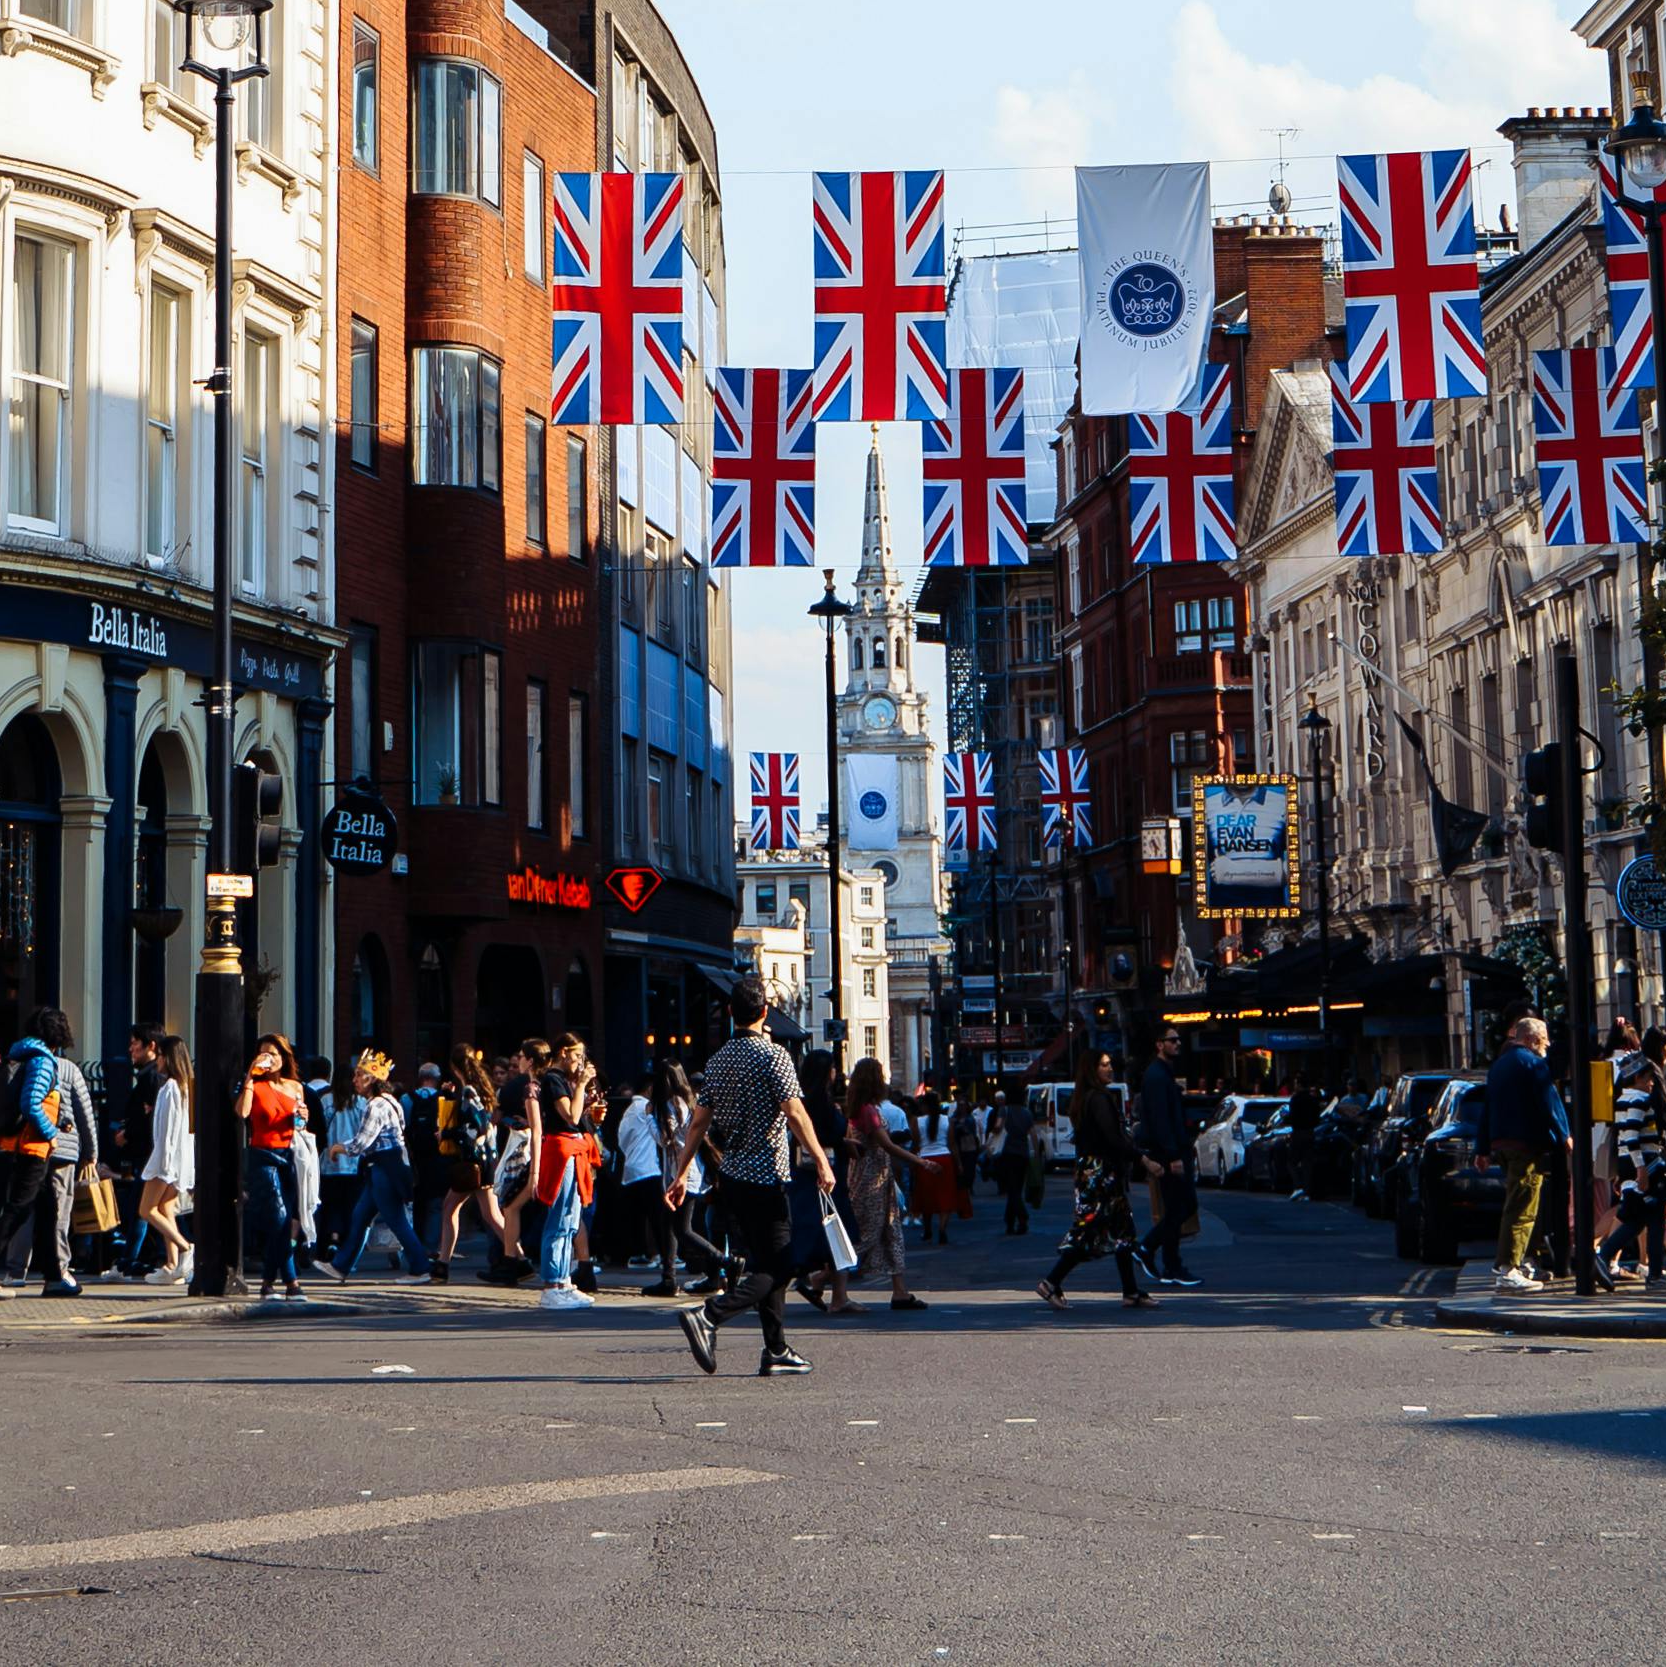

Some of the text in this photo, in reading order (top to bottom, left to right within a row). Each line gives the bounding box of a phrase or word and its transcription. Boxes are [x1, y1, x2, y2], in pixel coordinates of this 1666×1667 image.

[1104, 250, 1188, 278] THE QUEEN'S
[1096, 289, 1198, 351] PLATINUM JUBILEE 2022
[88, 602, 167, 657] Bella Italia
[1357, 603, 1383, 782] COWARD
[334, 810, 386, 837] Bella
[1217, 814, 1256, 827] DEAR
[1217, 827, 1254, 840] EVAN
[331, 838, 383, 864] Italia
[1217, 839, 1277, 852] HANSEN
